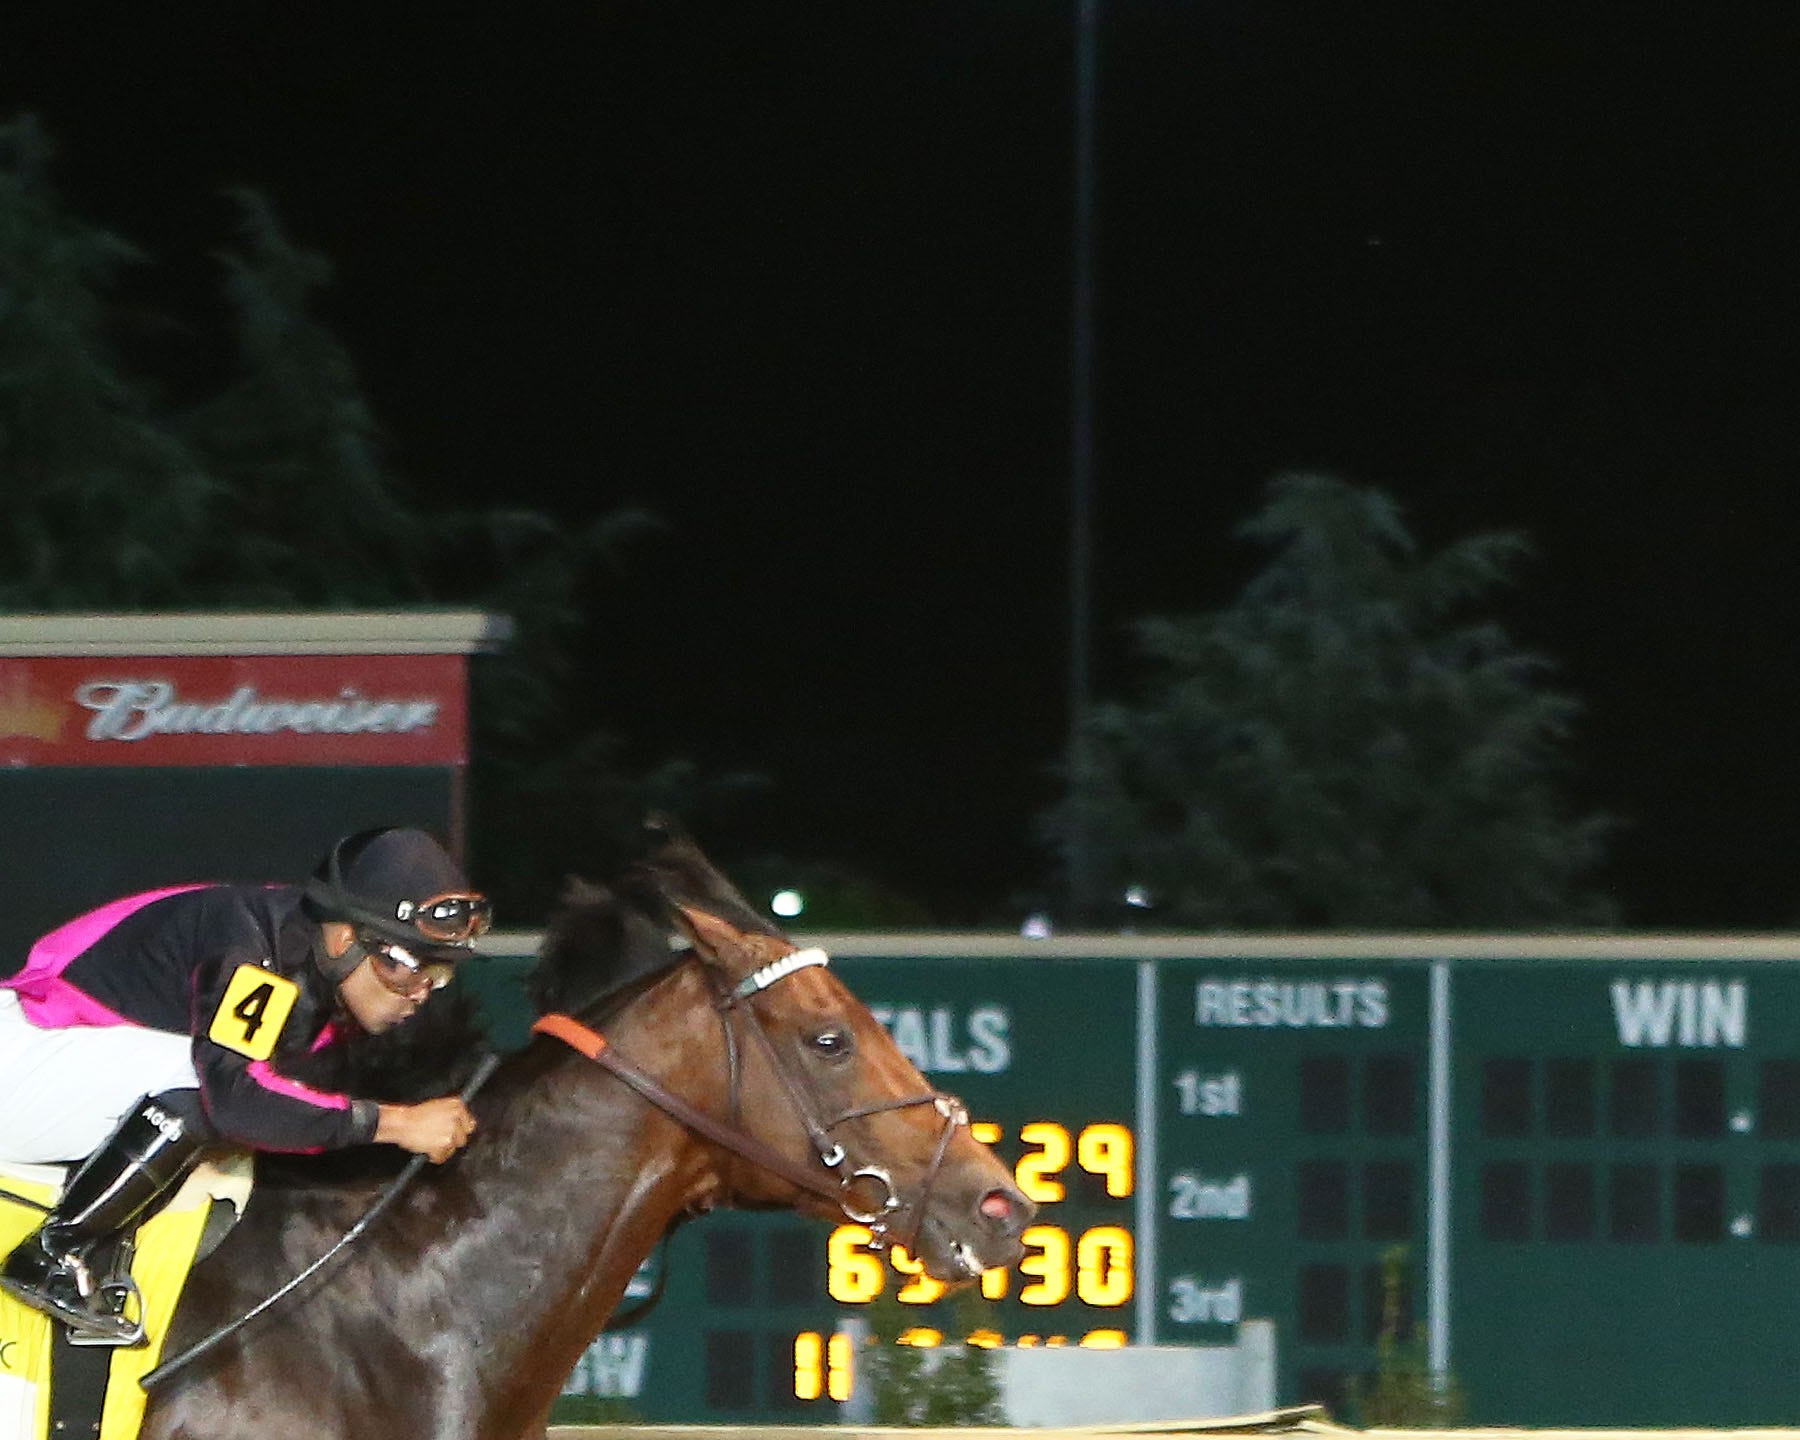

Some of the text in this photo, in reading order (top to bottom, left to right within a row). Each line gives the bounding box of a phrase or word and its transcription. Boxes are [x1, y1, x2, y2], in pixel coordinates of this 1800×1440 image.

[74, 679, 440, 742] Budweiser
[233, 982, 276, 1043] 4
[1197, 979, 1389, 1029] RESULTS
[1610, 978, 1748, 1049] WIN
[871, 1006, 1011, 1073] ALS
[1174, 1068, 1242, 1116] 1st
[970, 1122, 1136, 1203] 29
[1169, 1172, 1251, 1220] 2nd
[1170, 1277, 1242, 1324] 3rd
